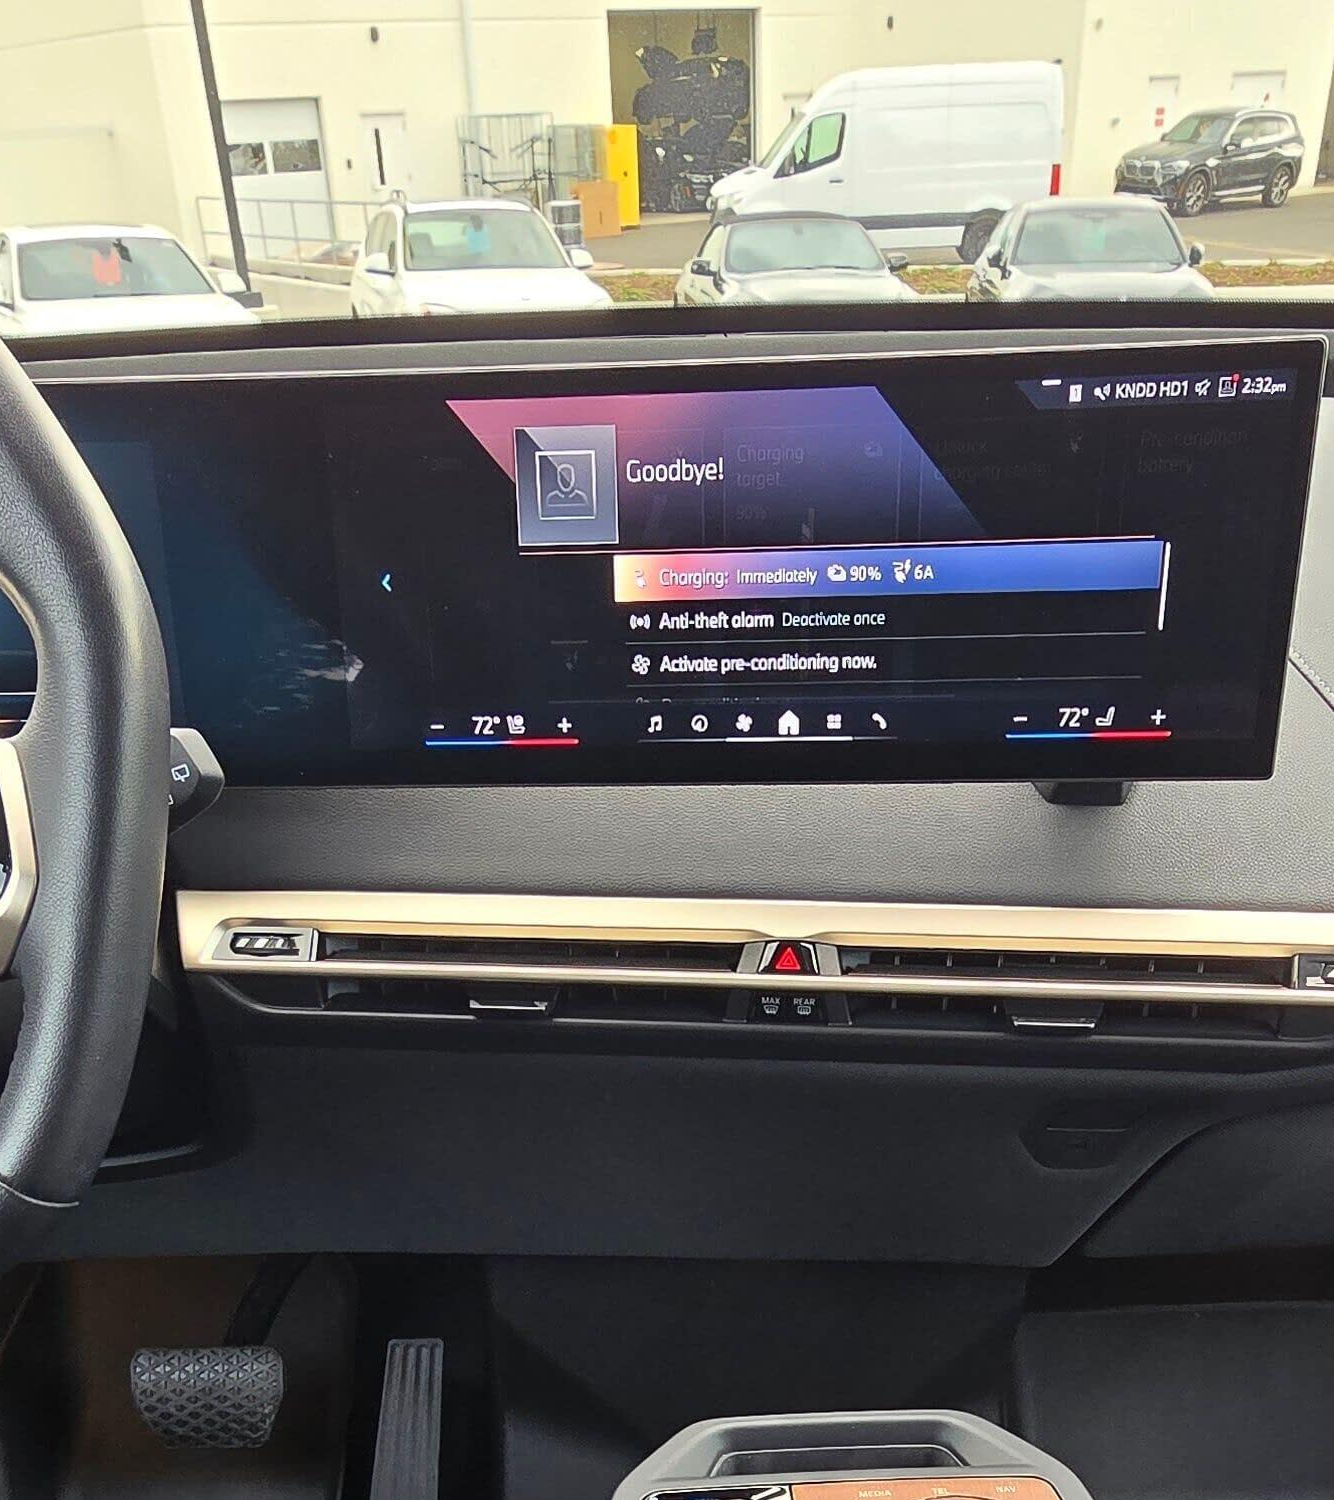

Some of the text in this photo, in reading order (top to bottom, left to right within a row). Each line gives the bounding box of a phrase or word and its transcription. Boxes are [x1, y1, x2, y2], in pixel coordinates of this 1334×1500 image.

[1115, 380, 1189, 400] KNDD HD1
[1241, 376, 1287, 395] 2:32pm
[735, 443, 805, 465] Charging
[625, 456, 725, 486] Goodbye!
[658, 563, 935, 590] Charging: Immediately 90% 6A
[658, 610, 886, 630] Anti-theft alarm Deactivate once
[659, 653, 878, 675] Activate pre-conditioning now.
[761, 996, 781, 1006] MAX
[793, 997, 816, 1006] REAR
[858, 1488, 892, 1499] MEDIA
[931, 1486, 949, 1496] TEL
[995, 1485, 1016, 1494] NAV
